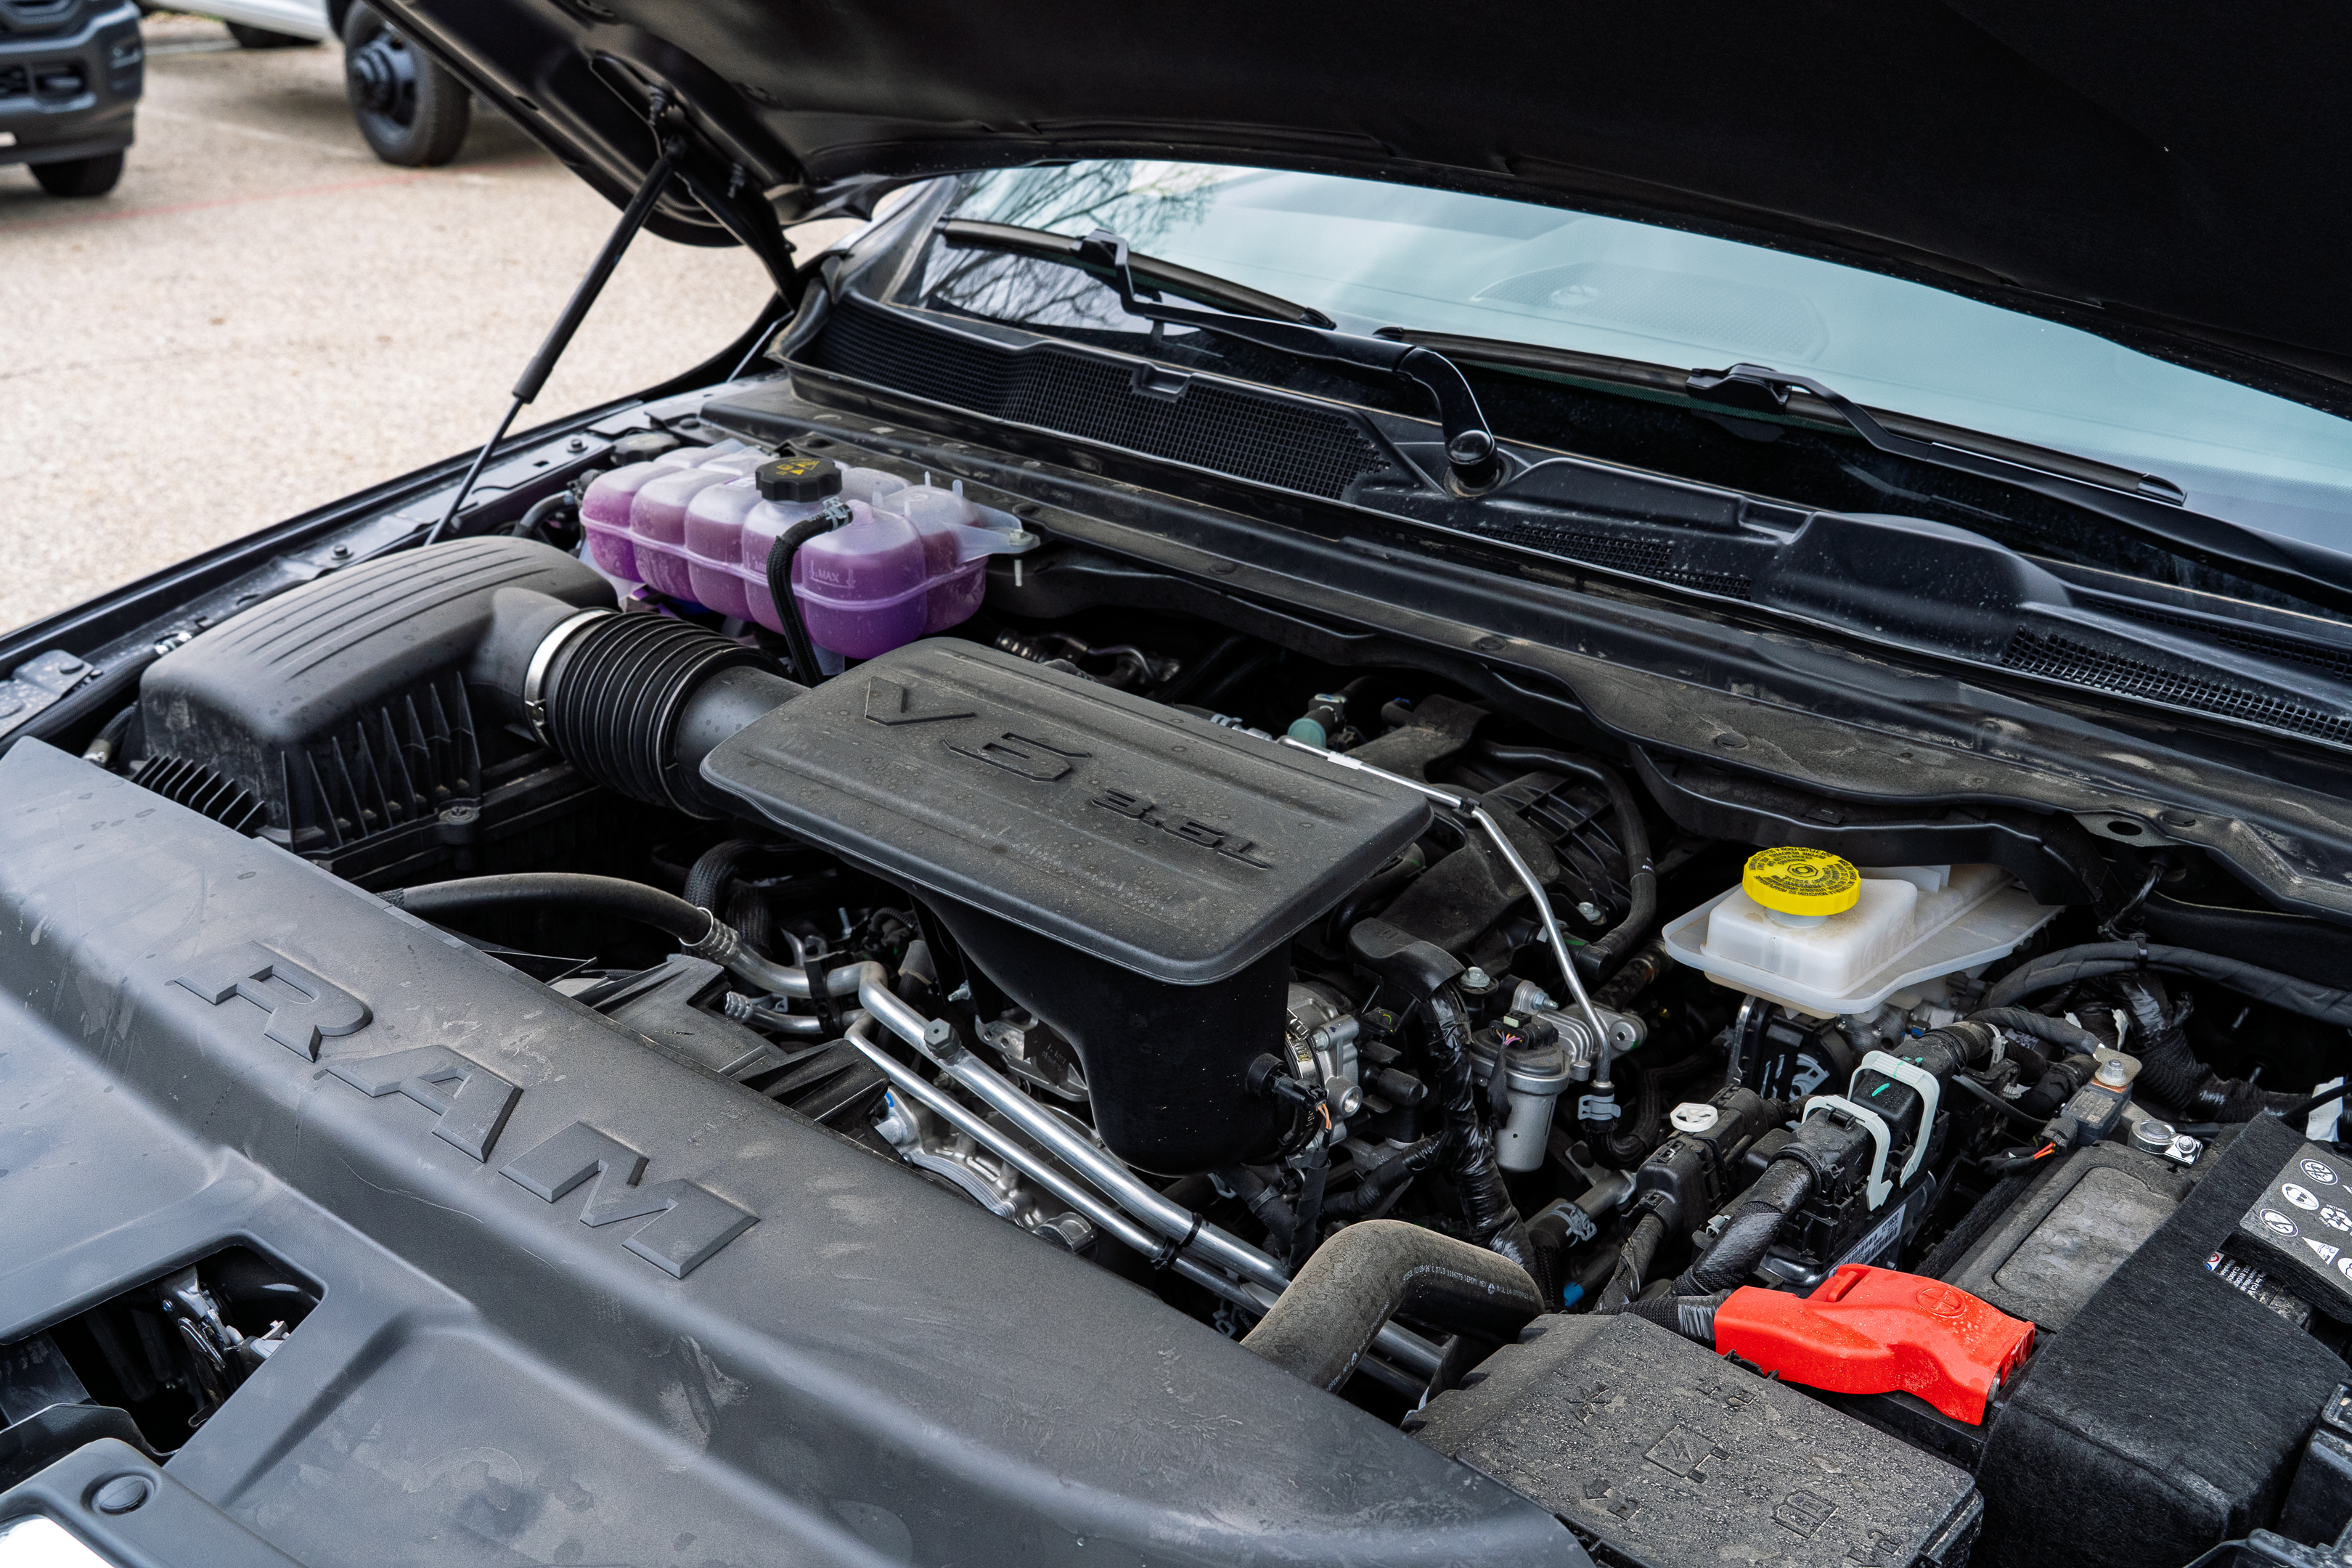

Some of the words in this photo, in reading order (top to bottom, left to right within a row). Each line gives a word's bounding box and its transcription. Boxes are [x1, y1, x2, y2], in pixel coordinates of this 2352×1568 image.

[818, 569, 840, 584] MAX
[173, 939, 761, 1279] RAM
[2326, 1204, 2347, 1213] RETURN
